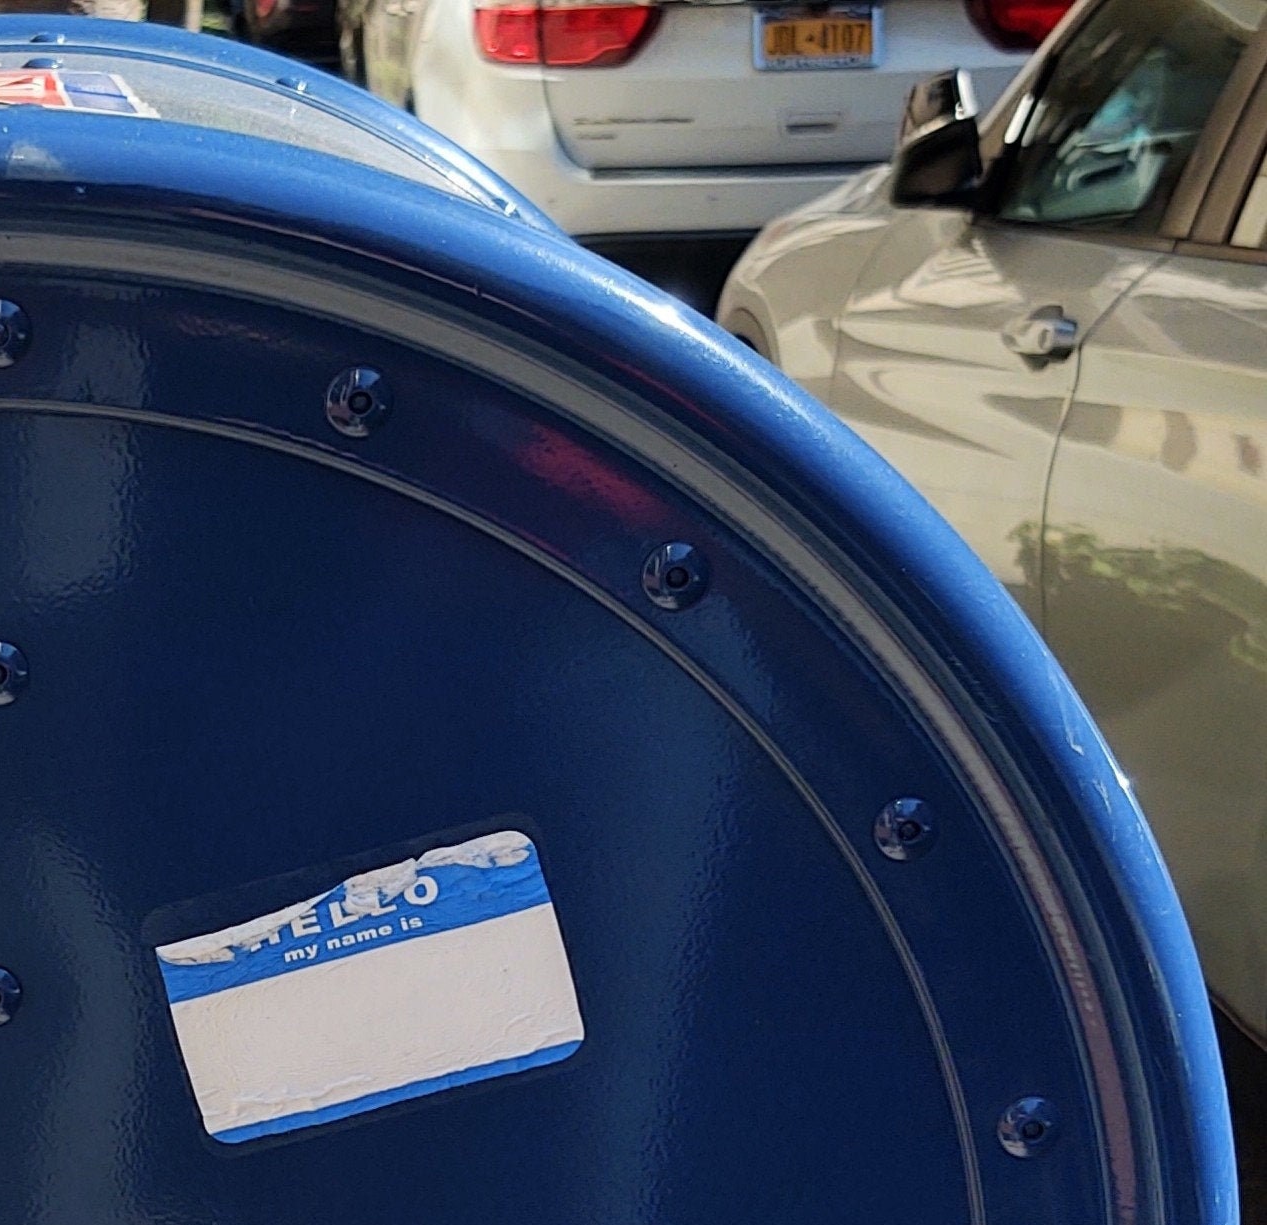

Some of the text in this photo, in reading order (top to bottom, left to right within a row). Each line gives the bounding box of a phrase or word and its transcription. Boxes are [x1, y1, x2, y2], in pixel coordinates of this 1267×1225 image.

[284, 915, 424, 963] my name is
